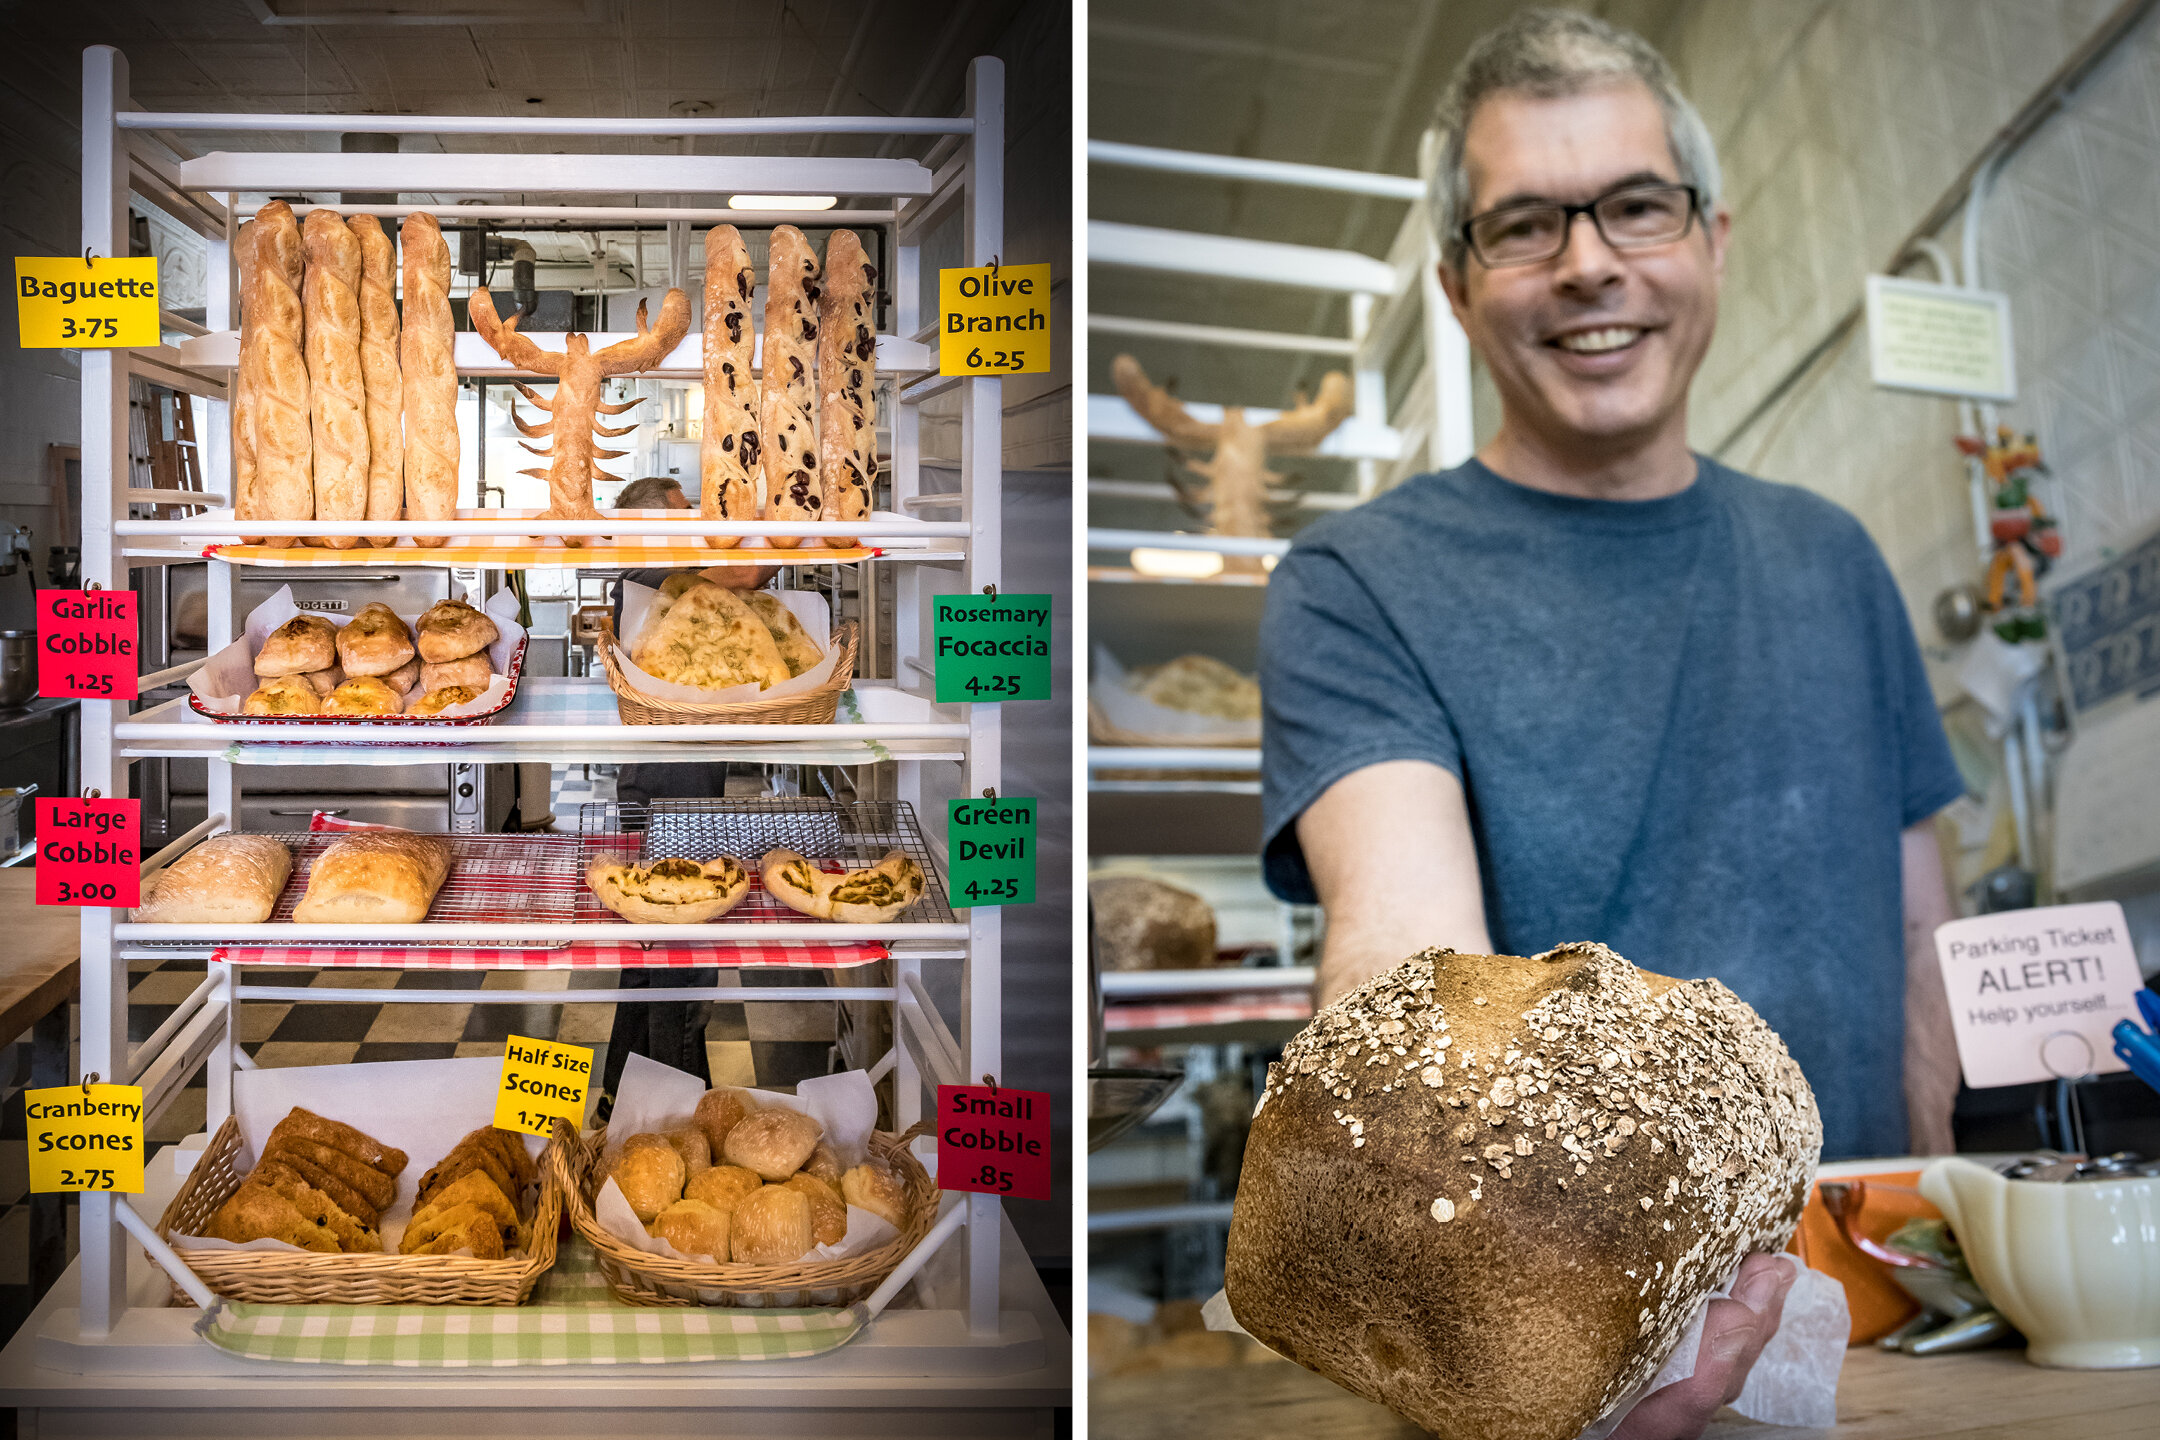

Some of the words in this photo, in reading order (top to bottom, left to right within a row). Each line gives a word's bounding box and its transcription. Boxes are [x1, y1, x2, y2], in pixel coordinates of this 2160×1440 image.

[20, 275, 155, 305] Baguette
[959, 274, 1034, 298] Olive
[61, 318, 118, 339] 3.75
[948, 307, 1045, 334] Branch
[966, 346, 1025, 371] 6.25
[52, 597, 126, 620] Garlic
[294, 601, 341, 610] ODGETT
[939, 605, 1049, 628] Rosemary
[45, 632, 132, 656] Cobble
[938, 635, 1049, 657] Focaccia
[65, 673, 114, 695] 1.25
[964, 674, 1021, 696] 4.25
[52, 806, 127, 835] Large
[953, 804, 1031, 826] Green
[43, 840, 133, 865] Cobble
[959, 836, 1025, 861] Devil
[57, 881, 117, 902] 3.00
[964, 877, 1019, 899] 4.25
[1950, 935, 2040, 960] Parking
[2044, 926, 2116, 949] Ticket
[1978, 956, 2106, 995] ALERT!
[1969, 1006, 2018, 1025] Help
[508, 1045, 550, 1066] Half
[552, 1053, 590, 1074] Size
[505, 1072, 582, 1103] Scones
[27, 1099, 142, 1127] Cranberry
[952, 1093, 1033, 1121] Small
[38, 1131, 133, 1152] Scones
[944, 1127, 1042, 1157] Cobble
[60, 1169, 115, 1190] 2.75
[970, 1164, 1014, 1192] .85
